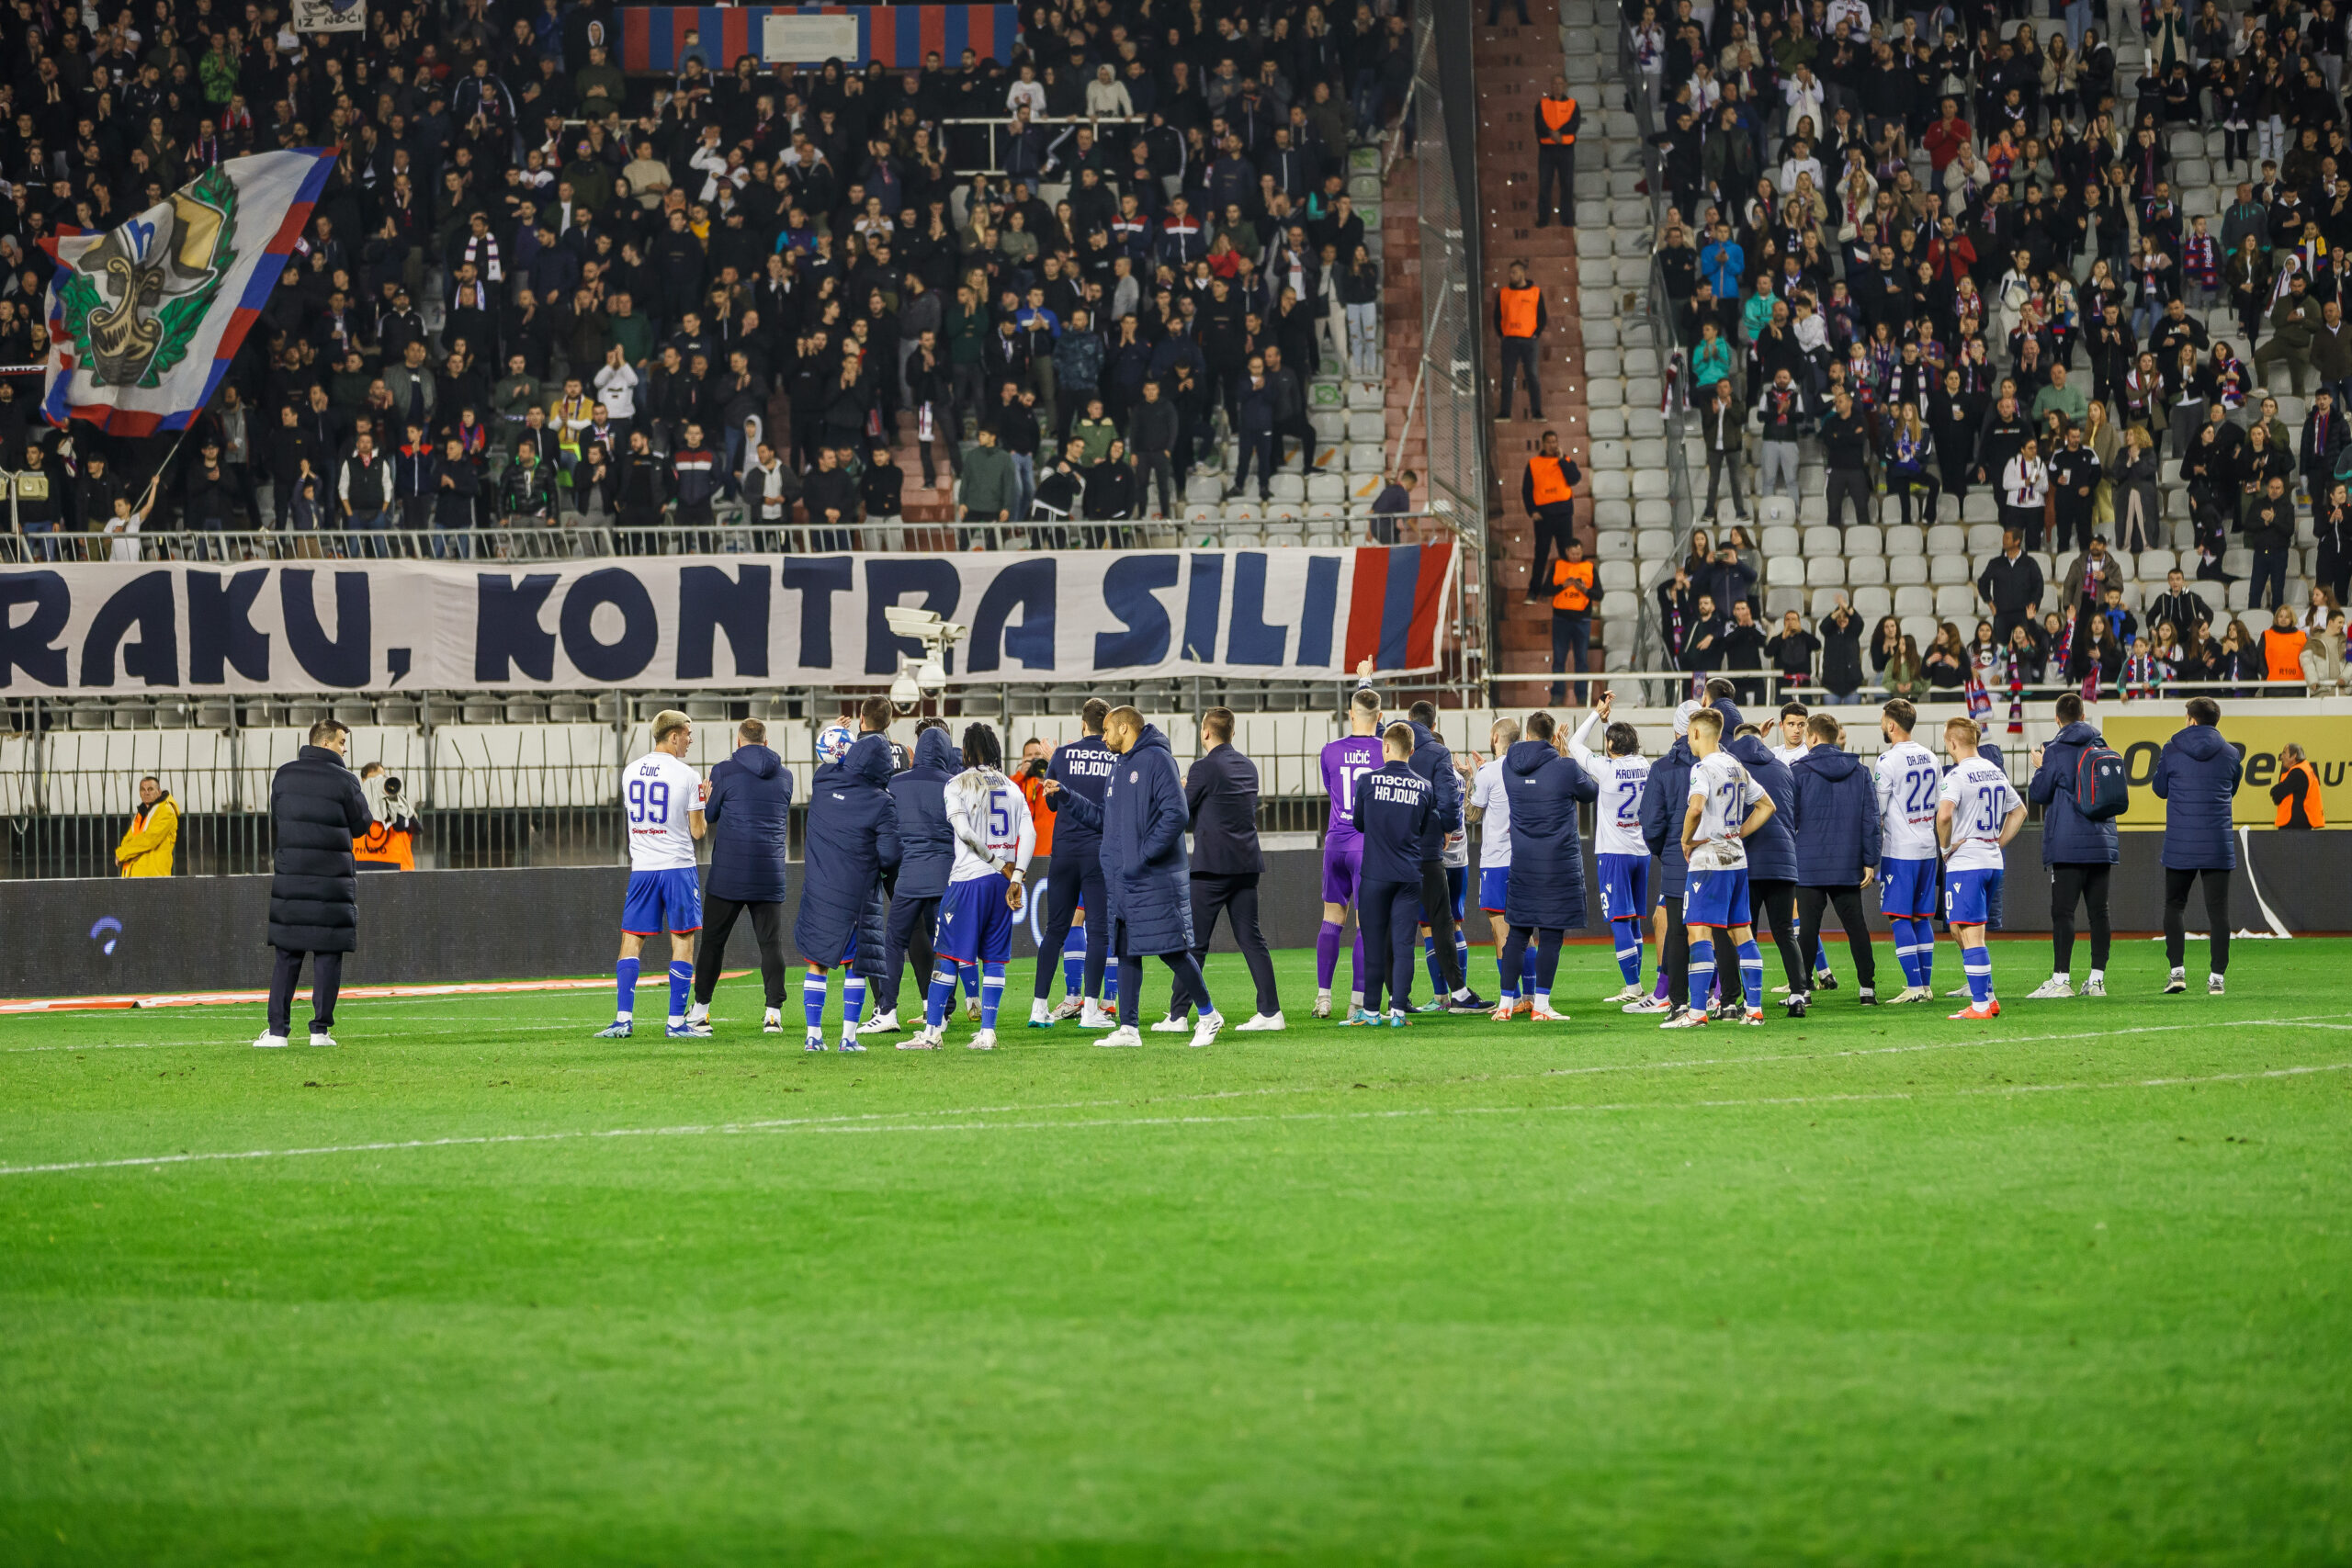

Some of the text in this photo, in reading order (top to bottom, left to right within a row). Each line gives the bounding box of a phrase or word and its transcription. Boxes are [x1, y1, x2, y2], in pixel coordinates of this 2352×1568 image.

[298, 18, 314, 27] IZ
[0, 552, 1342, 688] RAKU, KONTRA SILI
[639, 763, 660, 777] ČUIĆ
[1344, 749, 1370, 764] LUČIĆ
[629, 780, 669, 824] 99
[1371, 774, 1426, 791] macron
[1374, 785, 1420, 806] HAJDUK
[1723, 782, 1747, 826] 20
[1905, 768, 1936, 813] 22
[989, 790, 1009, 836] 5
[1977, 785, 2007, 831] 30
